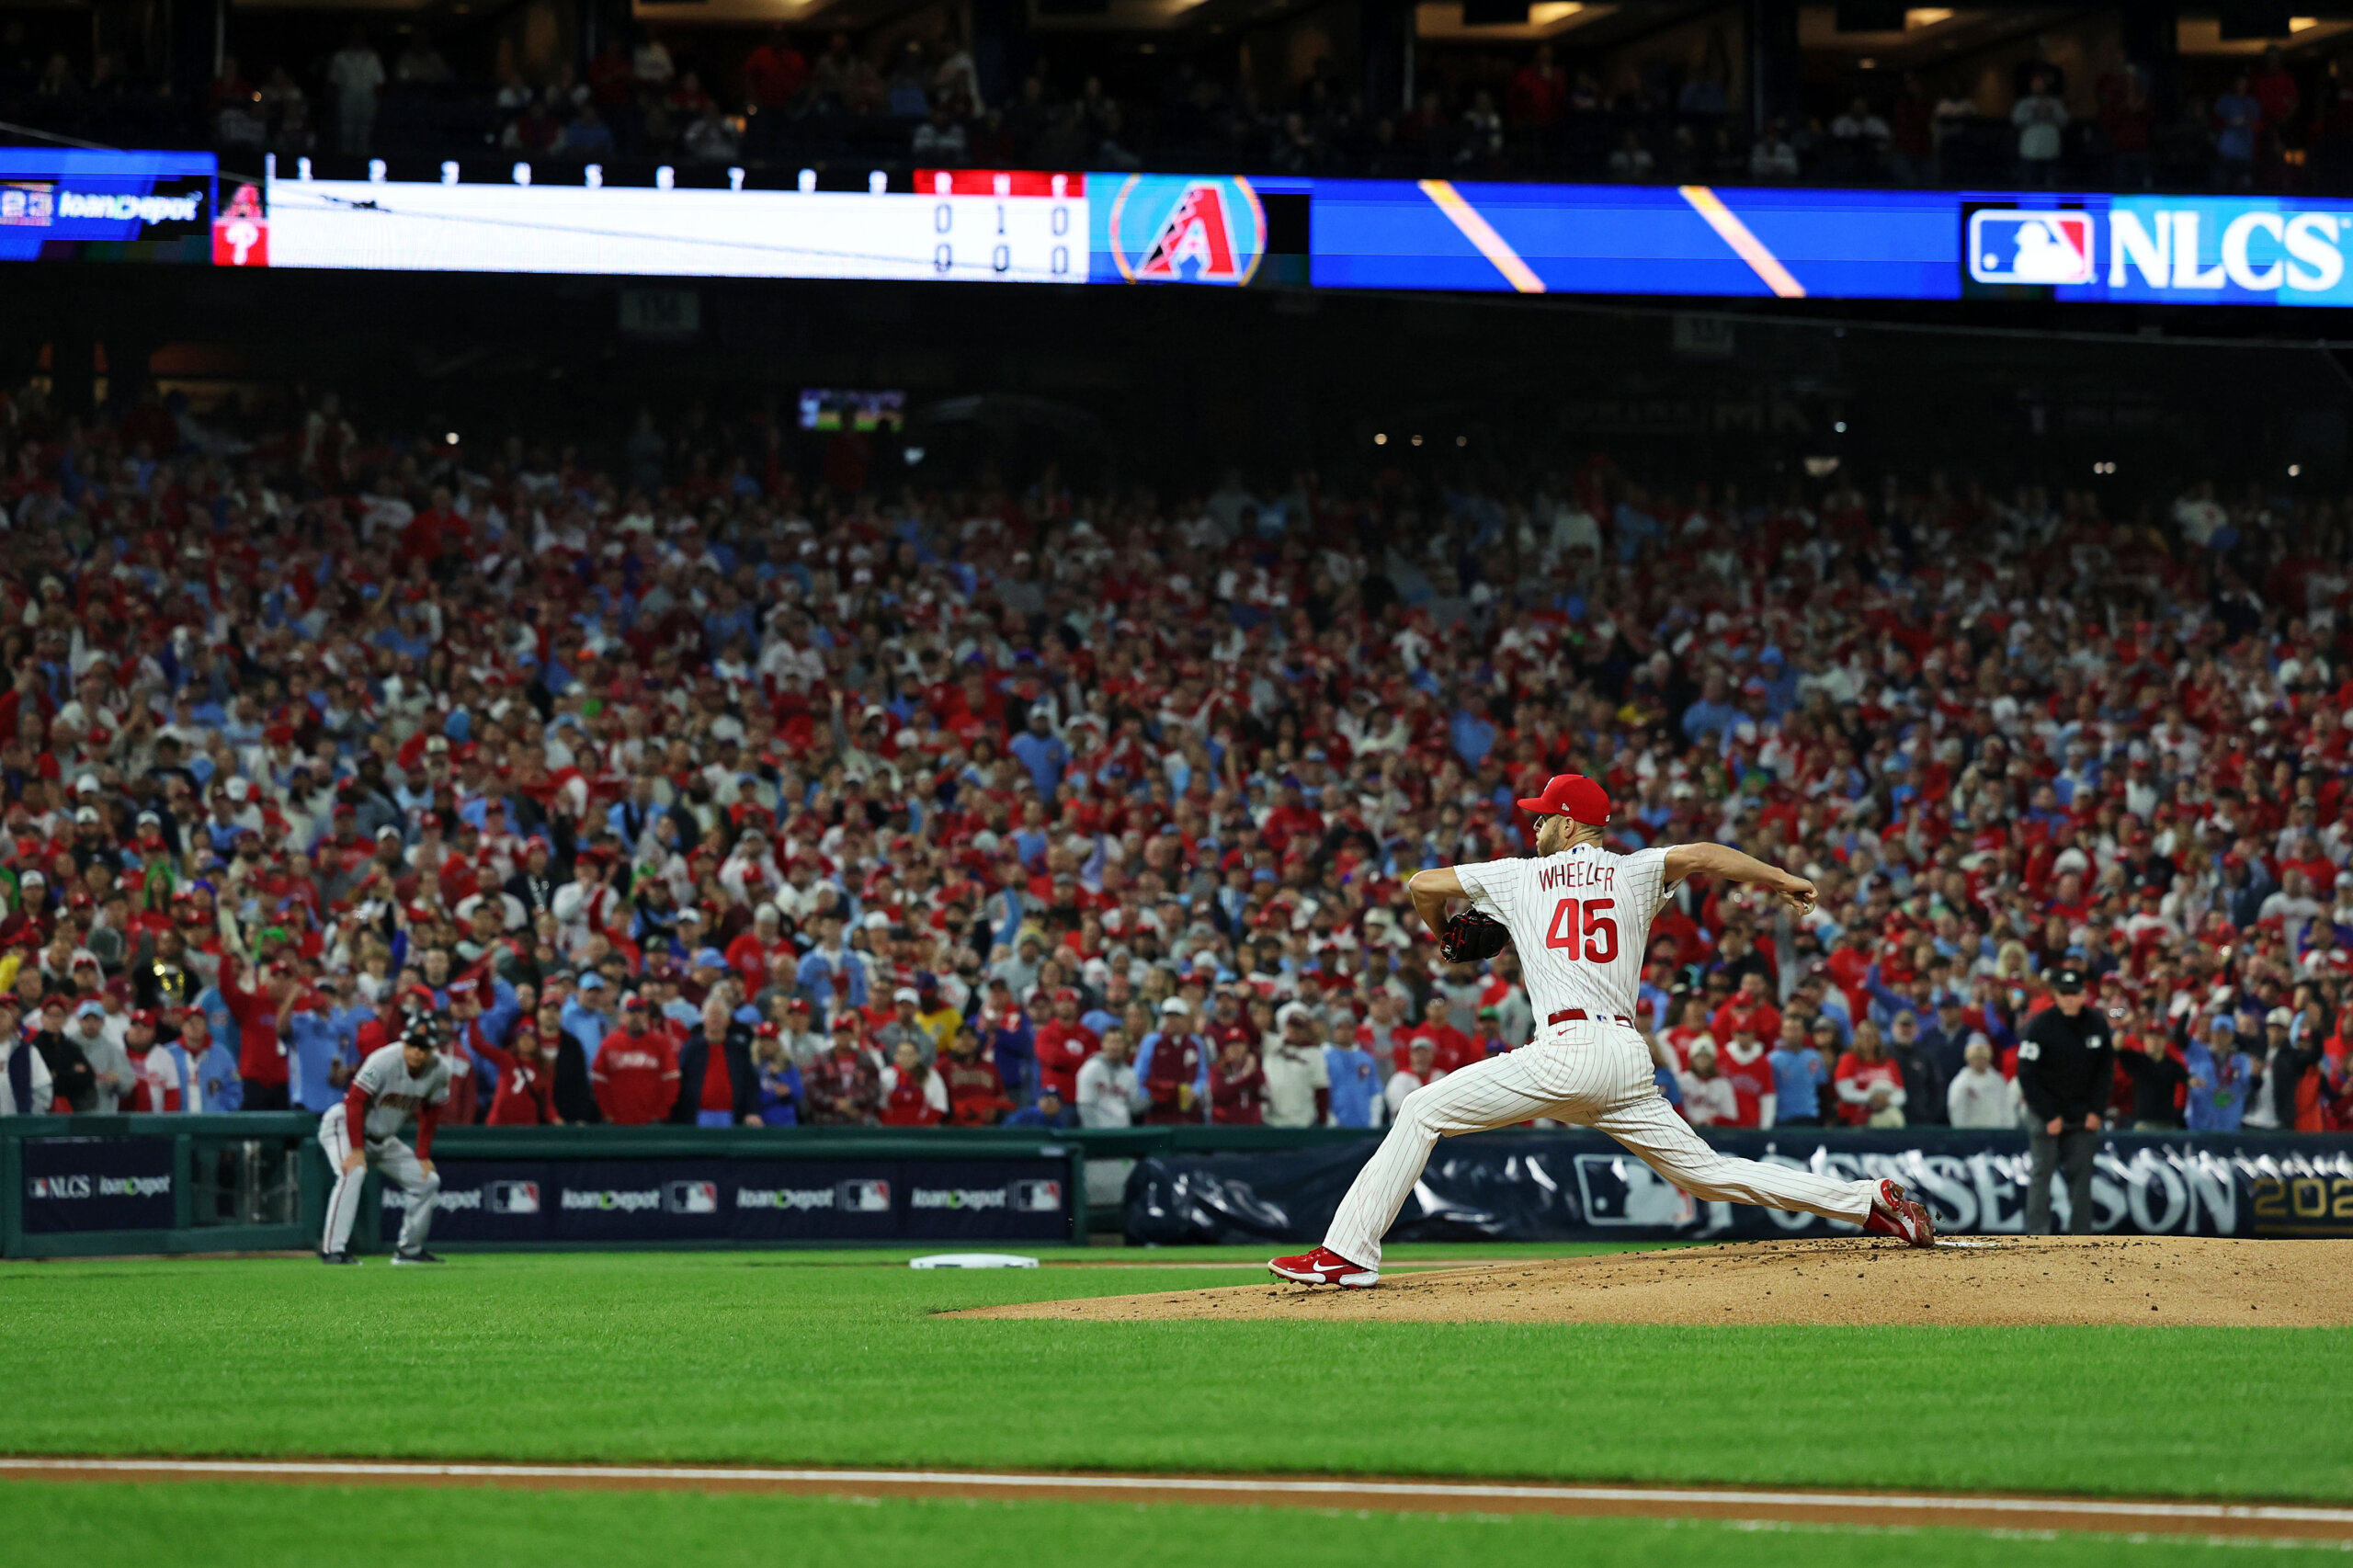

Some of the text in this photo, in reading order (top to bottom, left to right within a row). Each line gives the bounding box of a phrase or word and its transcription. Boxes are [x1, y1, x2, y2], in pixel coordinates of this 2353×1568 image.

[935, 203, 951, 234] 0
[995, 204, 1006, 235] 1
[1051, 206, 1068, 237] 0
[935, 244, 951, 273] 0
[993, 244, 1009, 273] 0
[1051, 245, 1068, 275] 0
[2109, 210, 2344, 291] NLCS
[1539, 861, 1615, 892] WHEELER
[1546, 898, 1619, 963] 45
[49, 1175, 91, 1199] NLCS
